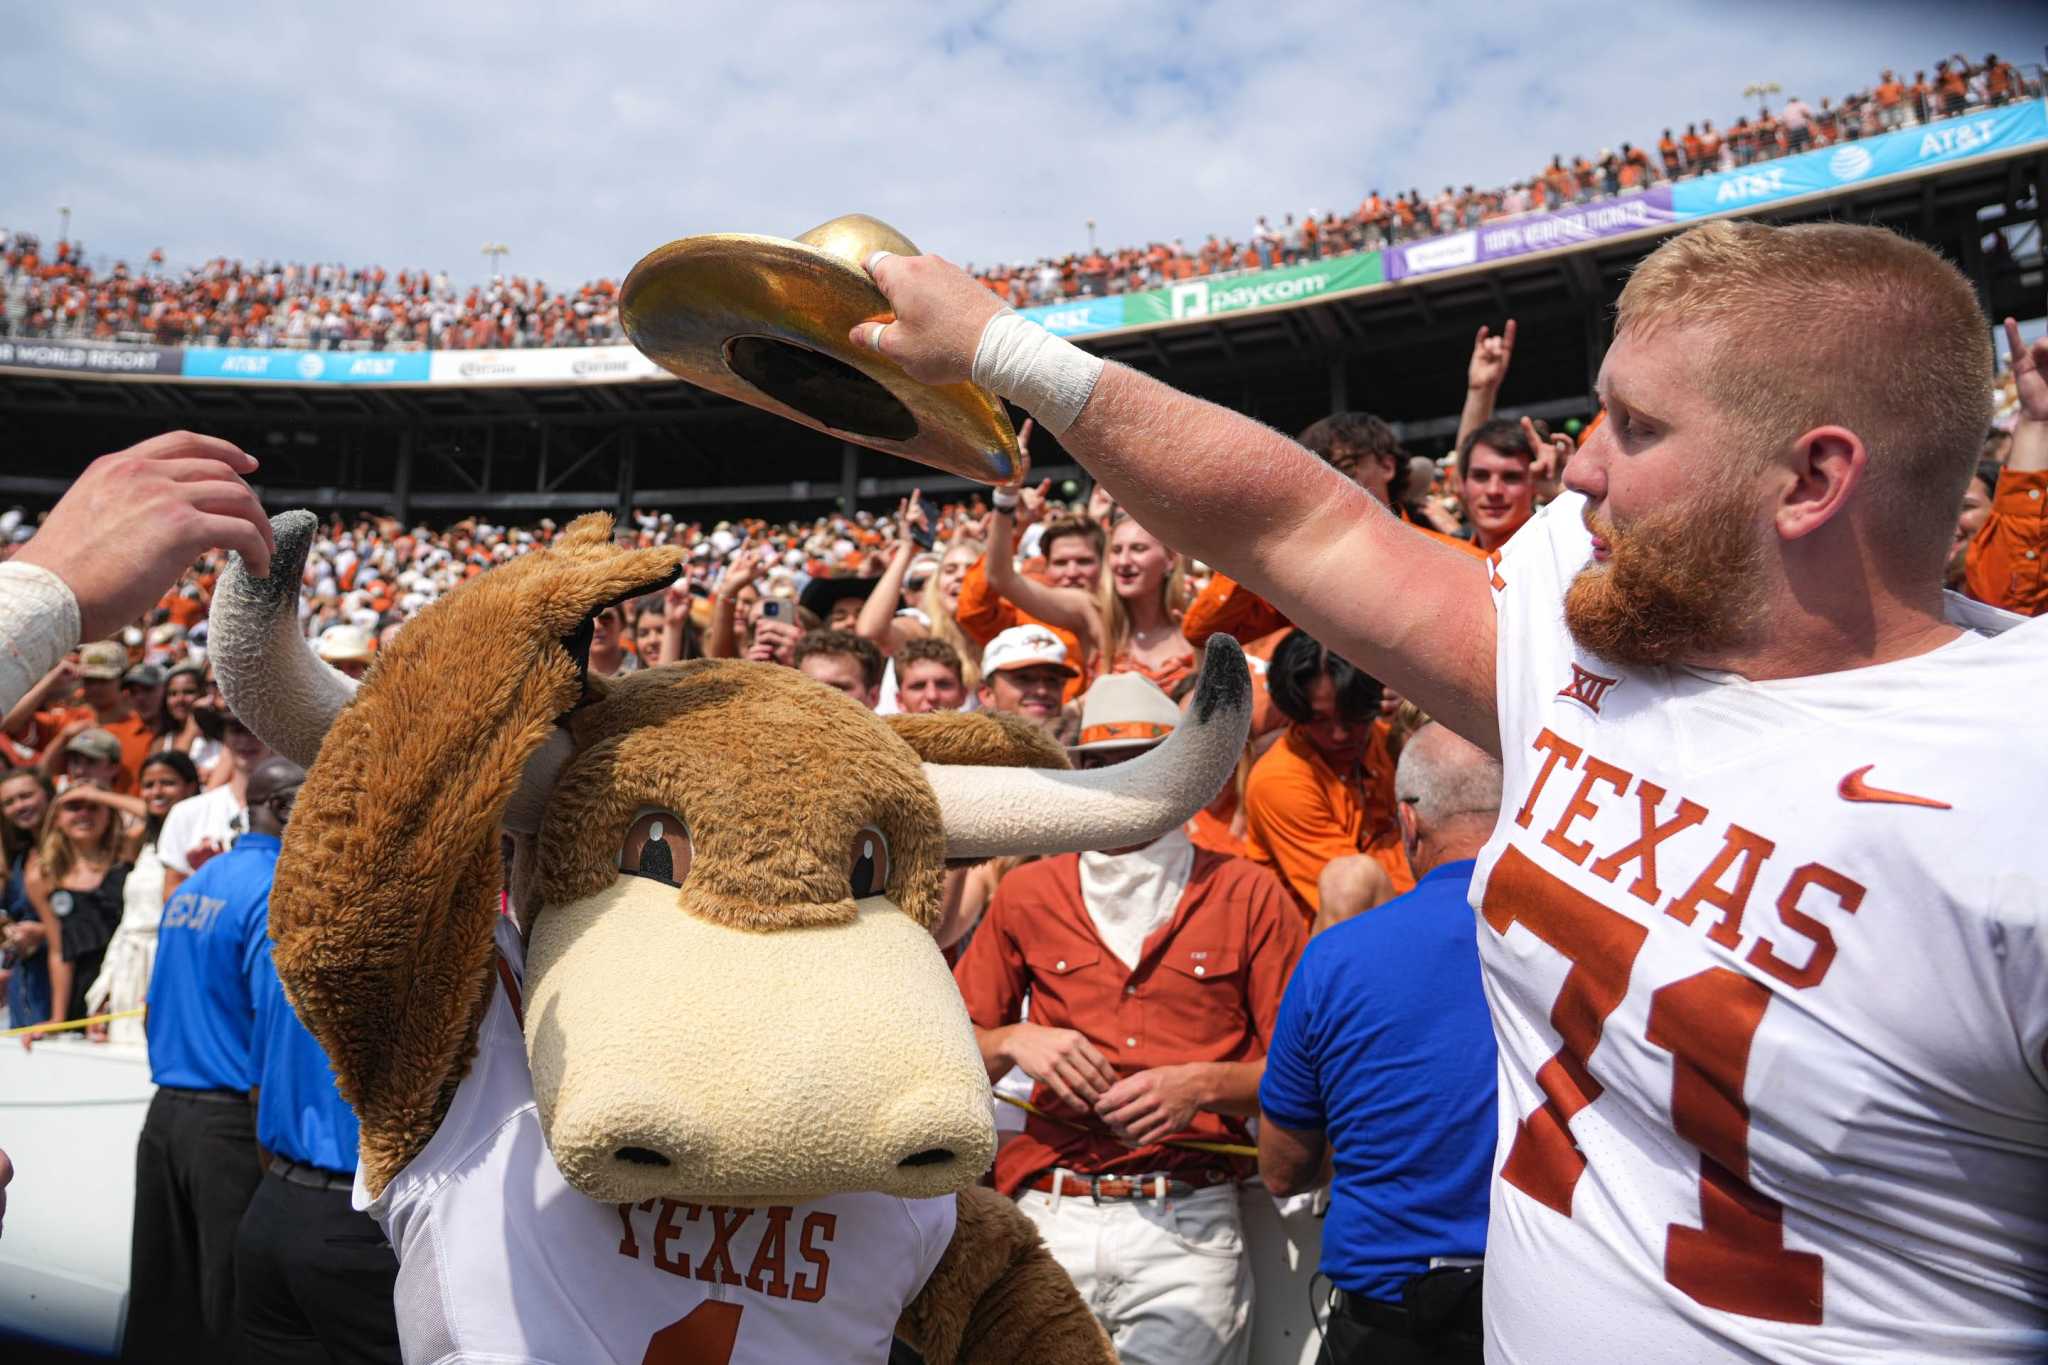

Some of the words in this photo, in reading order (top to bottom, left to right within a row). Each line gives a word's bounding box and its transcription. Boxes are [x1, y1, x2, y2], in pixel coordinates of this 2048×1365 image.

[1919, 118, 1995, 157] AT&T
[1716, 169, 1785, 203] AT&T
[1210, 274, 1328, 313] paycom
[16, 346, 86, 366] WORLD
[87, 350, 160, 370] RESORT
[1515, 728, 1867, 990] TEXAS
[1482, 843, 1824, 1326] 71
[618, 1197, 837, 1304] TEXAS
